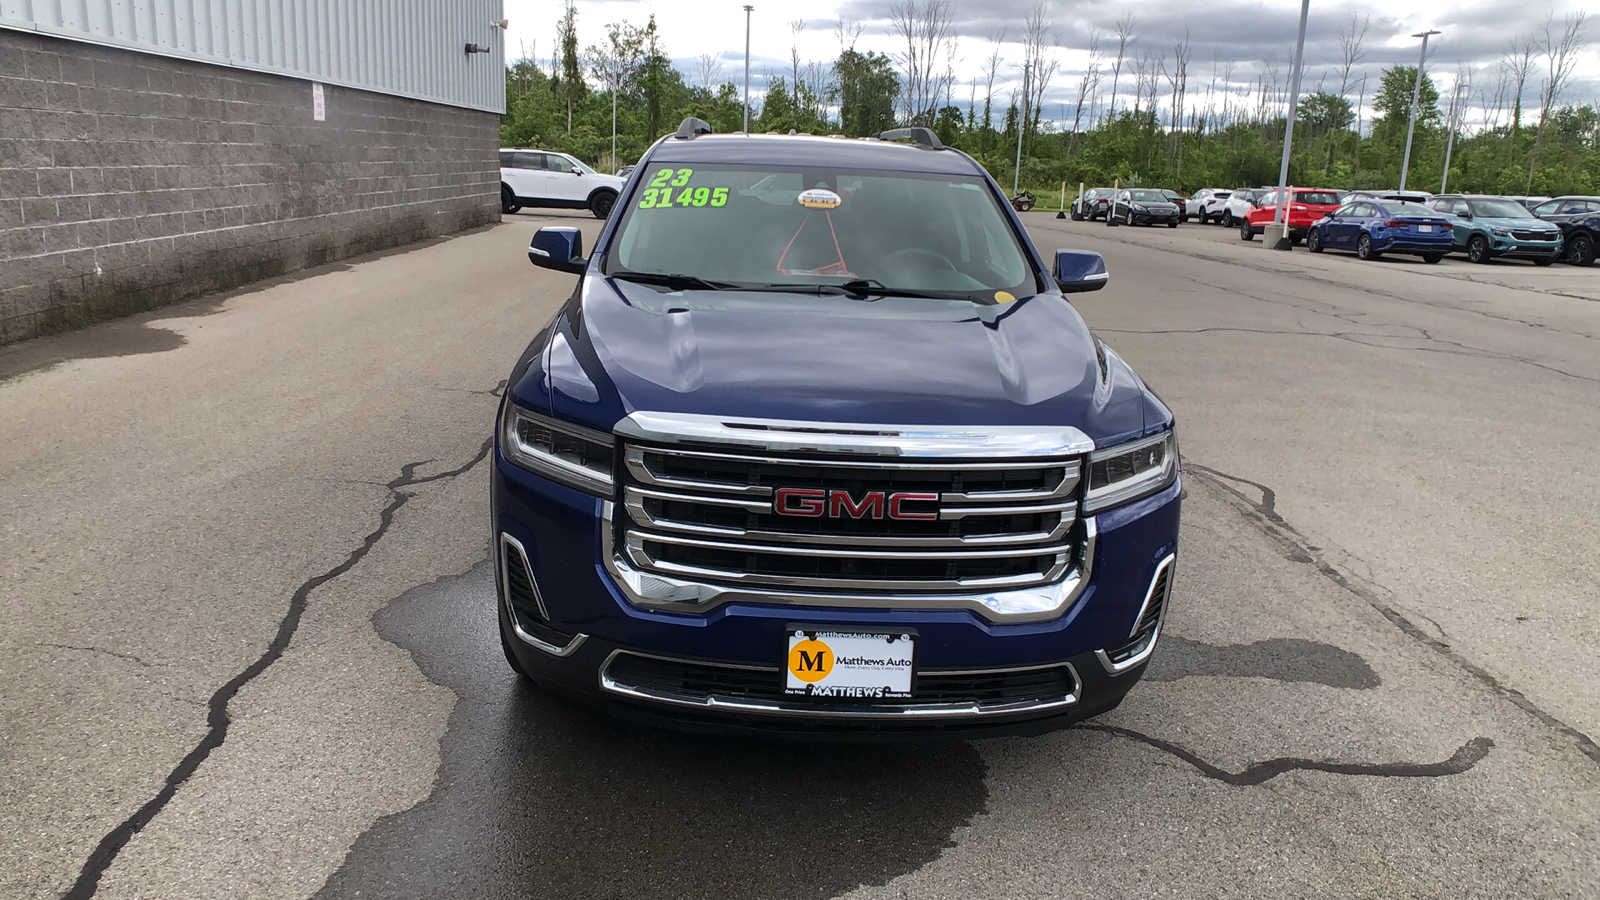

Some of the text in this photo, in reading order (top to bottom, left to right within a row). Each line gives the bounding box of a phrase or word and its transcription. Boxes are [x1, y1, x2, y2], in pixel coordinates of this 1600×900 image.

[650, 168, 693, 187] 23
[774, 488, 938, 520] GMC
[815, 631, 890, 640] MatthewsAuto.com
[796, 650, 826, 672] M
[836, 656, 912, 667] Matthews Auto
[811, 686, 884, 698] MATTHEWS
